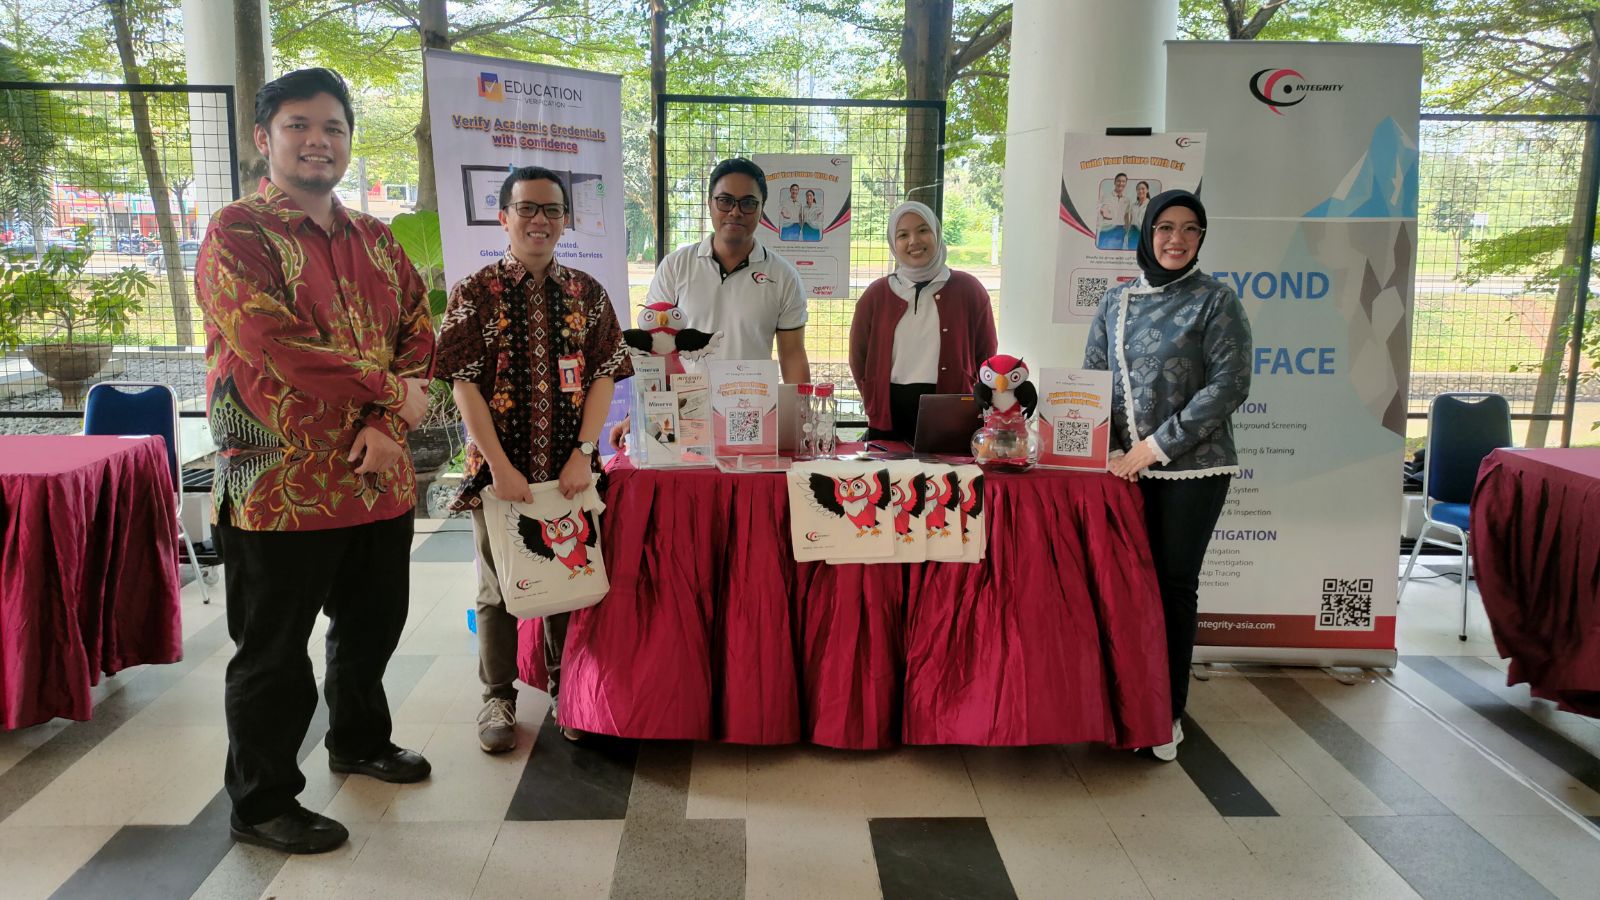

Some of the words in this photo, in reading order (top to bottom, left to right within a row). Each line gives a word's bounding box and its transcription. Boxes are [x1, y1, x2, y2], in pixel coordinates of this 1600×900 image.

[504, 80, 582, 102] EDUCATION
[1296, 84, 1344, 92] INTEGRITY
[453, 114, 491, 131] Verify
[494, 118, 548, 135] Academic
[550, 123, 606, 142] Credentials
[493, 134, 517, 147] with
[519, 136, 579, 153] Confidence
[1080, 157, 1103, 169] Build
[1103, 156, 1122, 165] Your
[1123, 155, 1149, 165] Future
[1150, 156, 1170, 168] With
[557, 241, 579, 249] rusted.
[555, 250, 578, 258] ication
[578, 251, 603, 259] Services
[1254, 347, 1336, 375] FACE
[1272, 422, 1307, 431] Screening
[1236, 447, 1258, 455] uiting
[1266, 447, 1295, 456] Training
[1233, 486, 1259, 494] System
[1234, 509, 1272, 517] Inspection
[1213, 529, 1277, 541] TIGATION
[1207, 559, 1254, 567] Investigation
[1215, 569, 1241, 578] Tracing
[1198, 620, 1276, 631] ntegrity-asia.com
